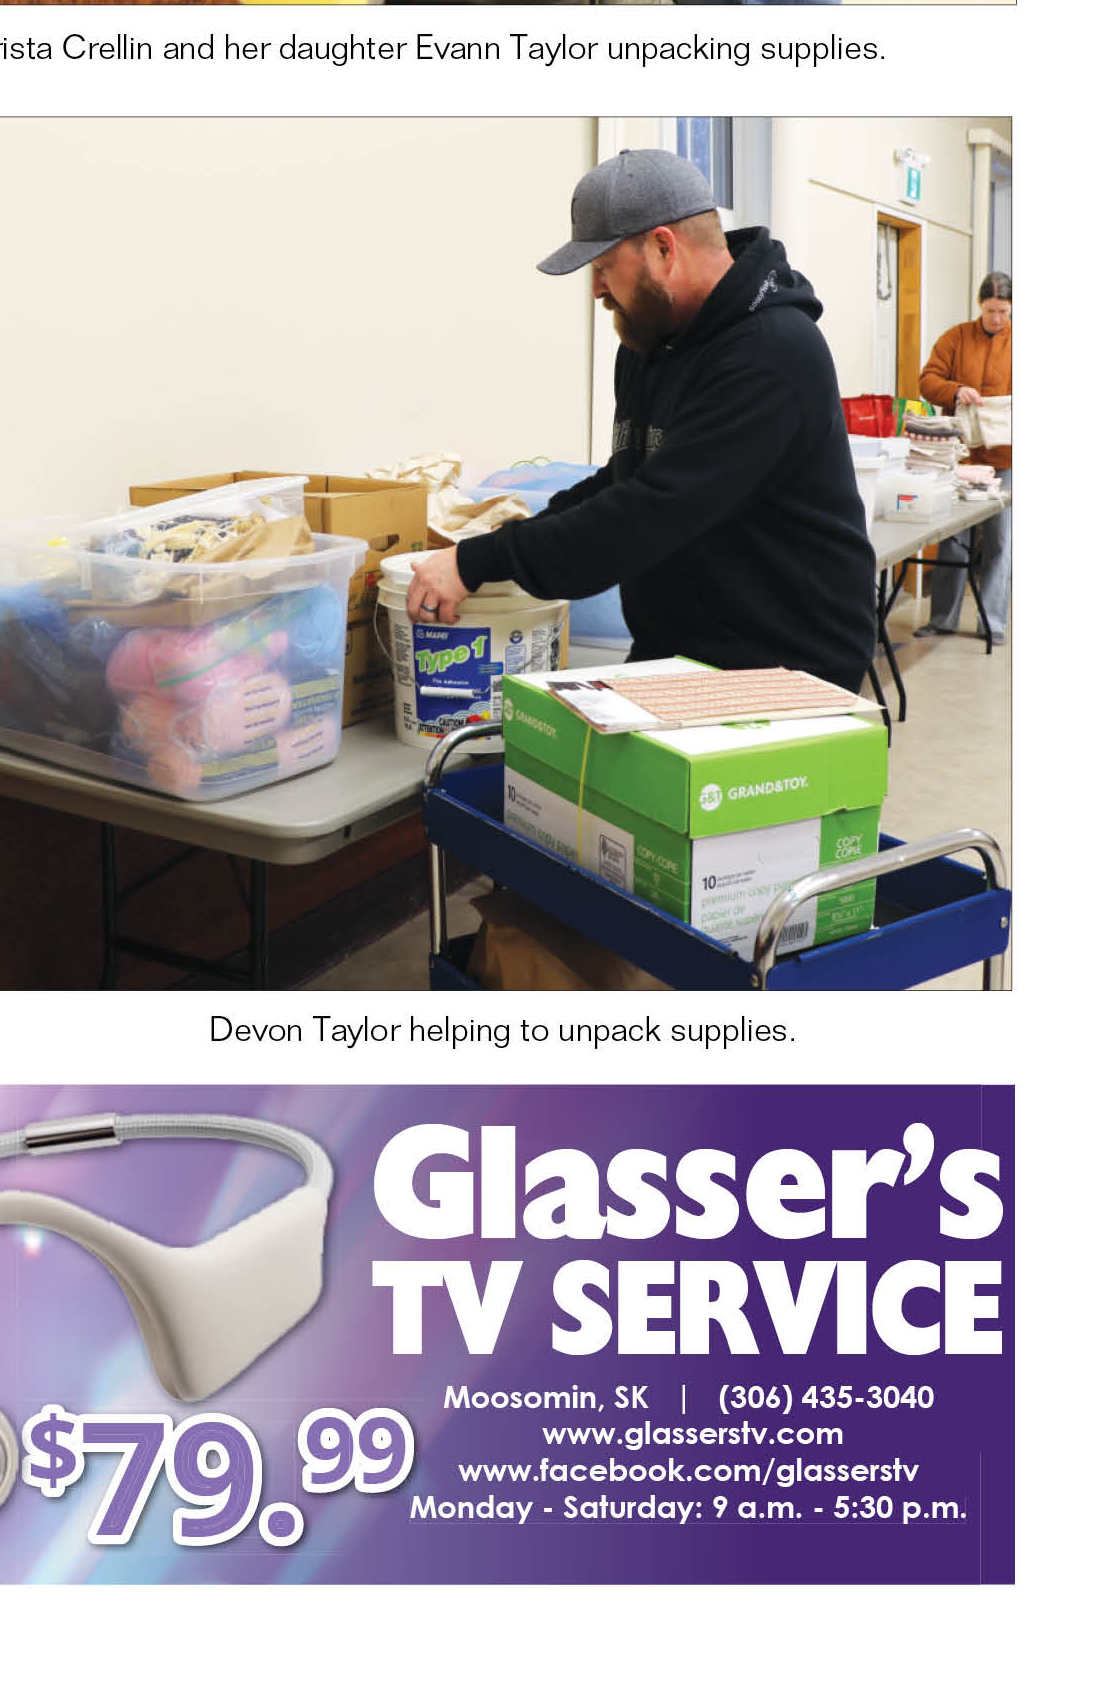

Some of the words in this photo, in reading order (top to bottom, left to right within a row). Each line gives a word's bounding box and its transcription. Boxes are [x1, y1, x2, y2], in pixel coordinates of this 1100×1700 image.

[63, 34, 151, 59] Crellin
[164, 34, 213, 59] and
[226, 34, 271, 59] her
[280, 34, 407, 66] daughter
[417, 34, 499, 59] Evann
[510, 34, 598, 66] Taylor
[609, 34, 749, 67] unpacking
[762, 34, 884, 67] supplies.
[415, 645, 470, 675] Type
[471, 635, 488, 658] 1
[728, 776, 809, 800] GRAND&TOY
[702, 875, 717, 890] 10
[211, 1016, 301, 1041] Devon
[313, 1016, 401, 1048] Taylor
[411, 1016, 509, 1049] helping
[521, 1020, 548, 1041] to
[560, 1016, 660, 1049] unpack
[672, 1016, 794, 1049] supplies.
[372, 1261, 523, 1354] TV
[553, 1260, 1002, 1355] SERVICE
[444, 1385, 603, 1411] Moosomin,
[615, 1386, 648, 1408] SK
[720, 1385, 792, 1414] (306)
[802, 1386, 933, 1408] 435-3040
[543, 1421, 842, 1450] www.glasserstv.com
[459, 1458, 918, 1487] www.facebook.com/glasserstv
[411, 1495, 533, 1524] Monday
[564, 1495, 701, 1524] Saturday:
[714, 1496, 727, 1517] 9
[739, 1502, 801, 1518] a.m.
[834, 1496, 892, 1518] 5:30
[904, 1502, 966, 1524] p.m.
